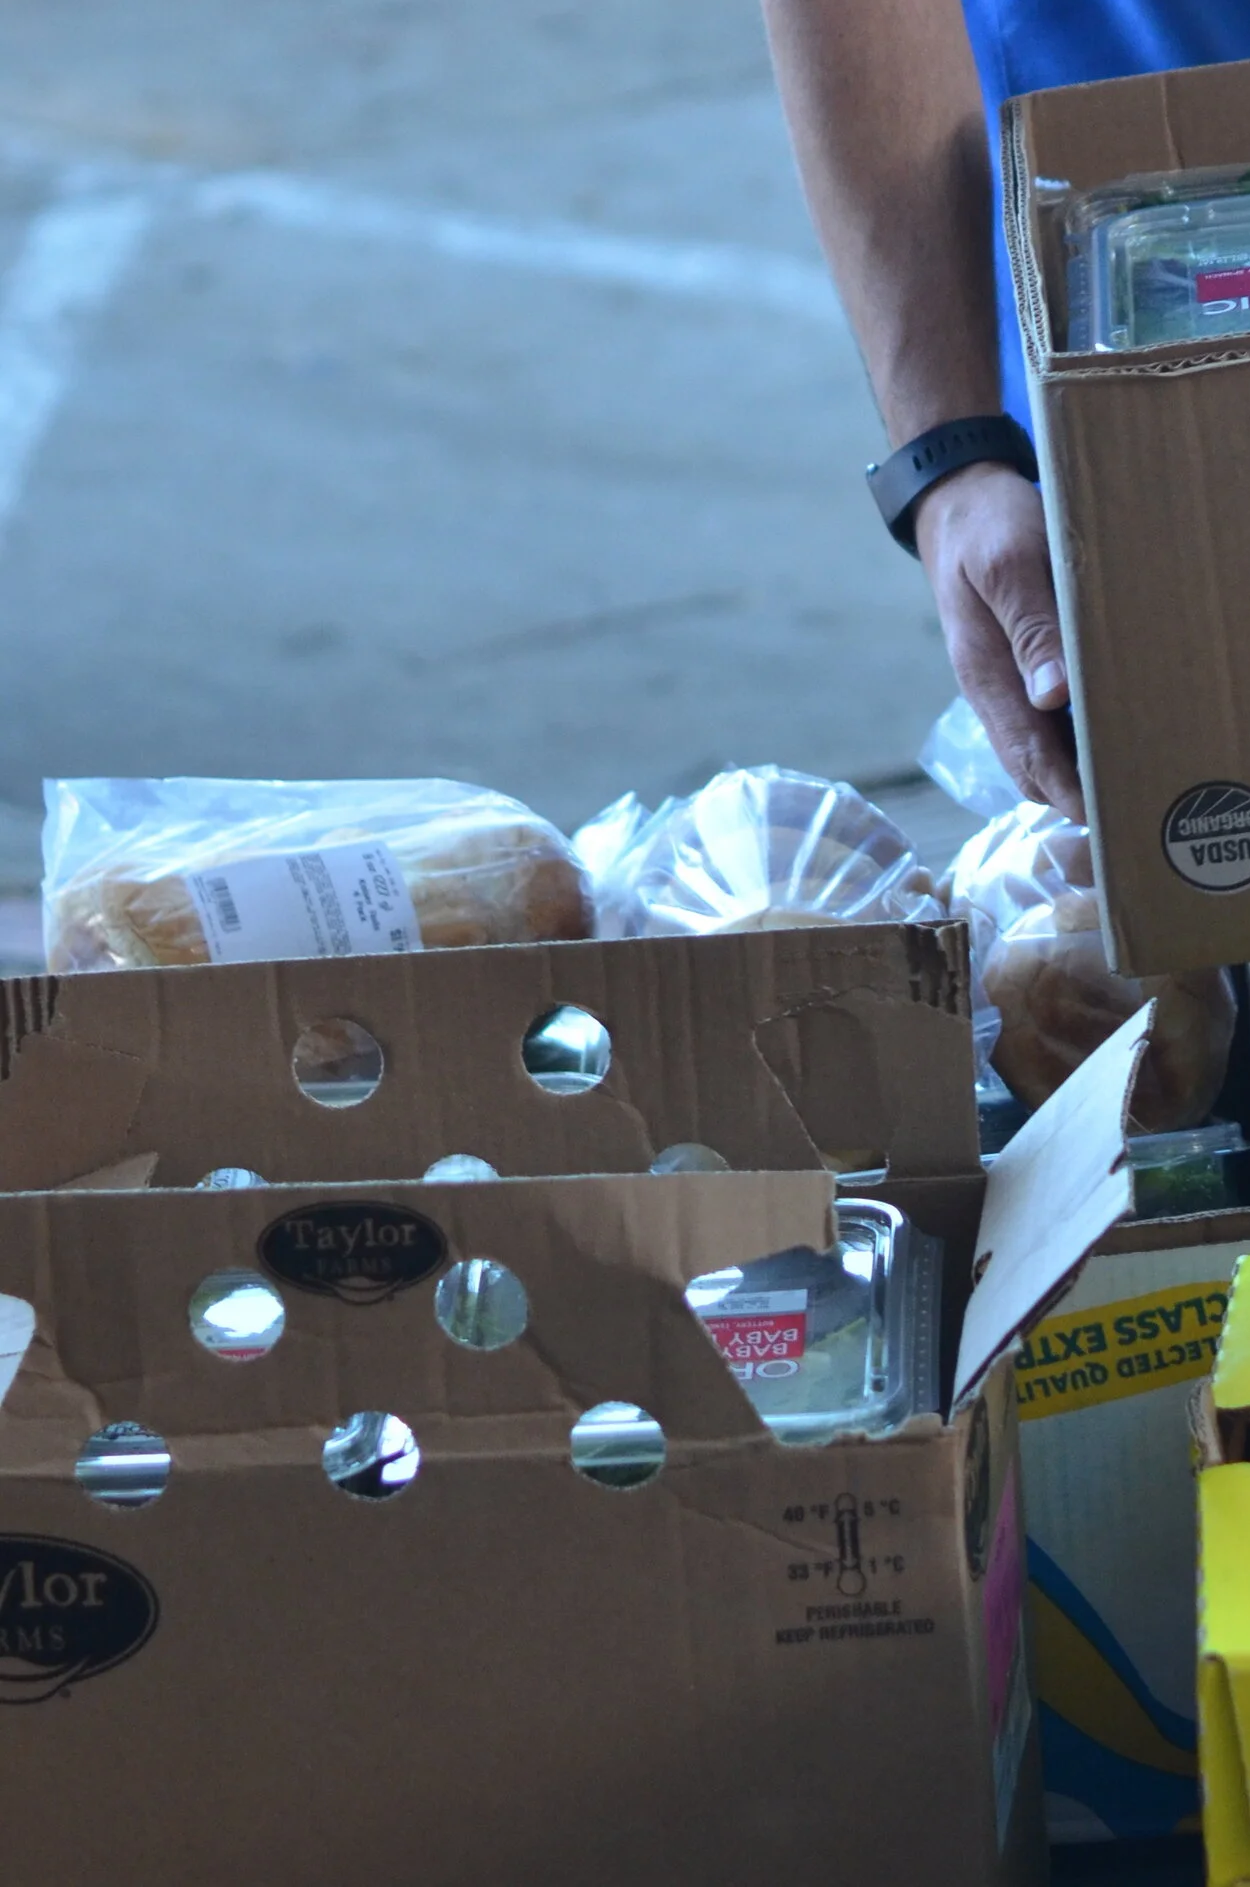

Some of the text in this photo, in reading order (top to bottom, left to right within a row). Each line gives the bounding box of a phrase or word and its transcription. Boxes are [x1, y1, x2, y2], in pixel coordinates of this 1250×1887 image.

[284, 1218, 417, 1258] Taylor
[1114, 1294, 1228, 1345] CLASS
[729, 1328, 798, 1345] BABY
[721, 1343, 788, 1358] BABY
[806, 1600, 901, 1622] PERISHABLE
[776, 1619, 935, 1644] KEEP REFRIGERATED
